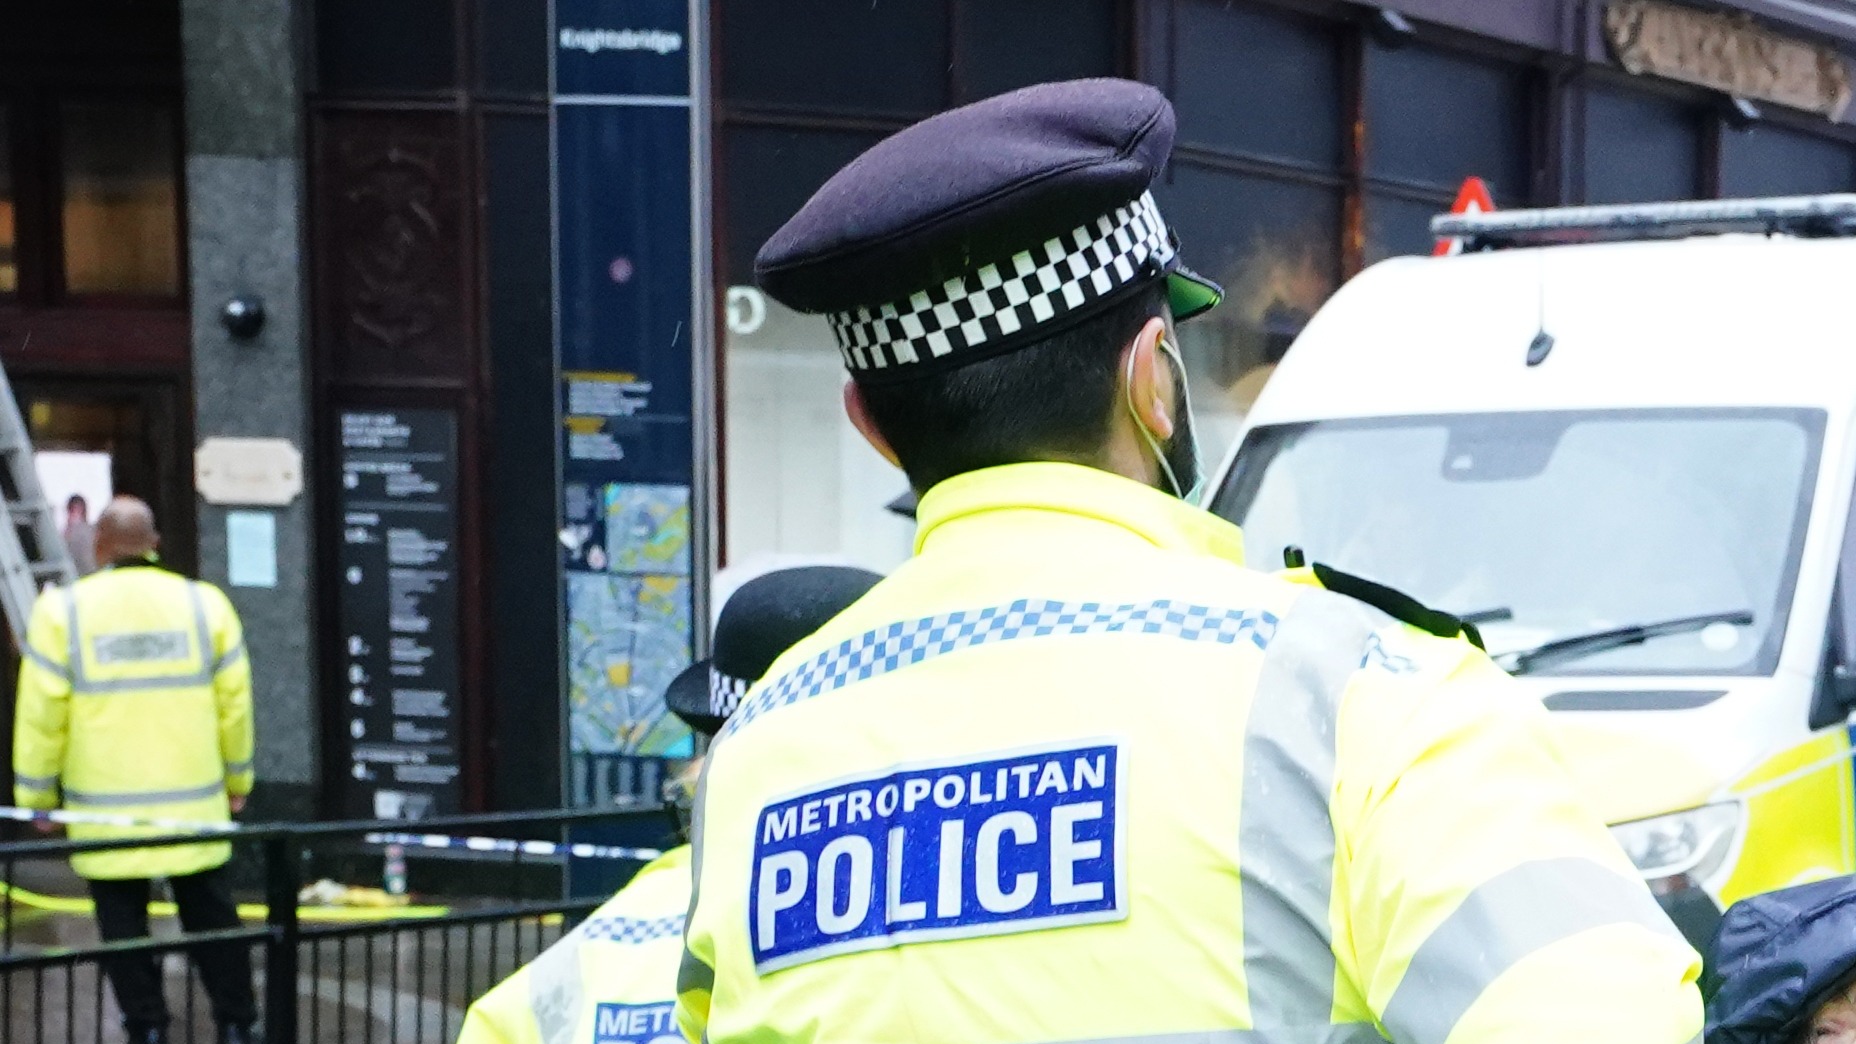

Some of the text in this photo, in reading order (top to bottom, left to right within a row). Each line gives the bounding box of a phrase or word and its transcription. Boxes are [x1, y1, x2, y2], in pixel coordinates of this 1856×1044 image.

[560, 27, 682, 55] Knightsbridge
[763, 754, 1107, 845] METROPOLITAN
[757, 800, 1105, 952] POLICE
